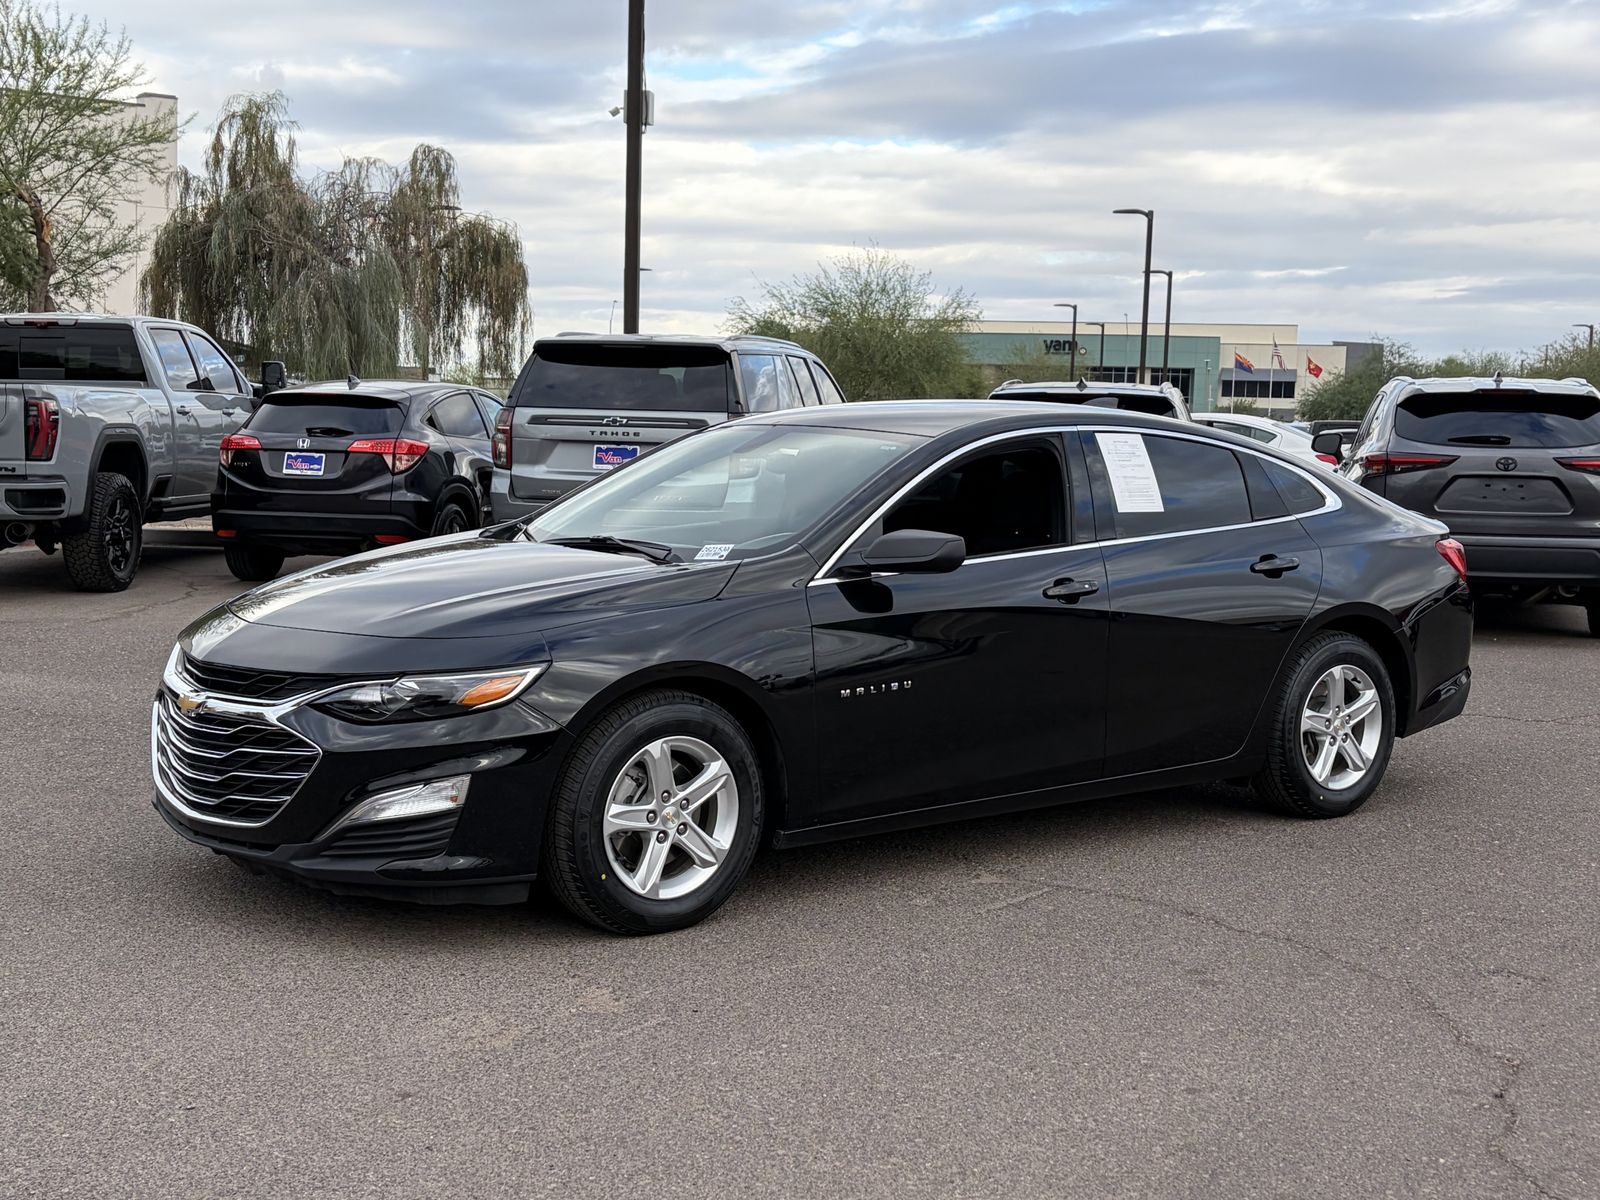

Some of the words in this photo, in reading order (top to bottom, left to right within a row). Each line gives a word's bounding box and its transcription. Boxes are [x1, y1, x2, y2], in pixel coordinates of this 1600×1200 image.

[287, 458, 310, 470] Van
[597, 451, 623, 464] Van
[840, 680, 912, 698] MALIBU
